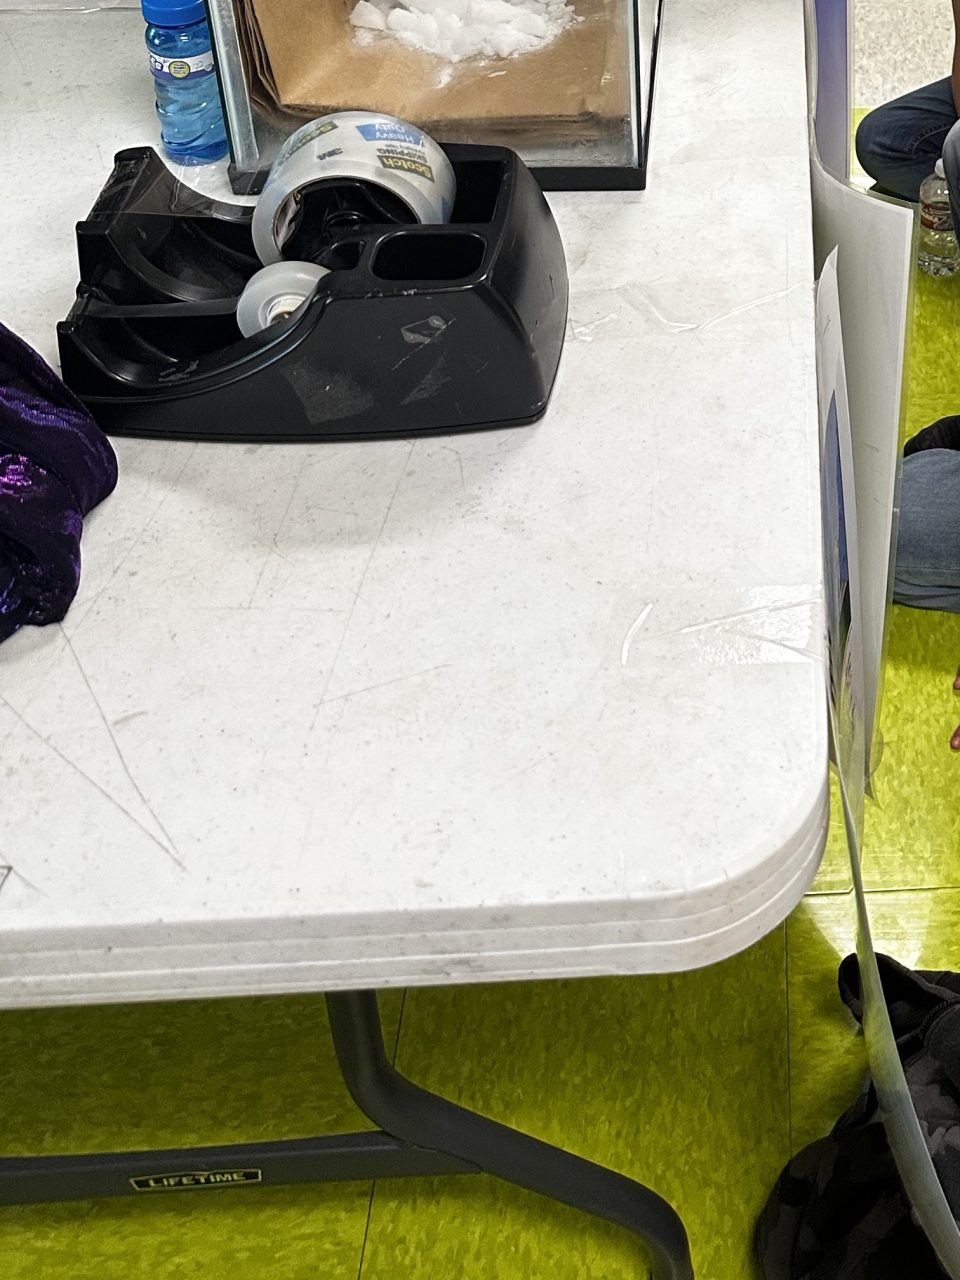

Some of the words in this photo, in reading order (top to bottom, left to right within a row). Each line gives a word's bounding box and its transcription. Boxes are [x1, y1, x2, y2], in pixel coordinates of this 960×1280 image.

[375, 131, 415, 144] Heavy
[316, 147, 344, 161] 3M
[382, 157, 432, 178] Scotch
[149, 1171, 246, 1187] LIFETIME
